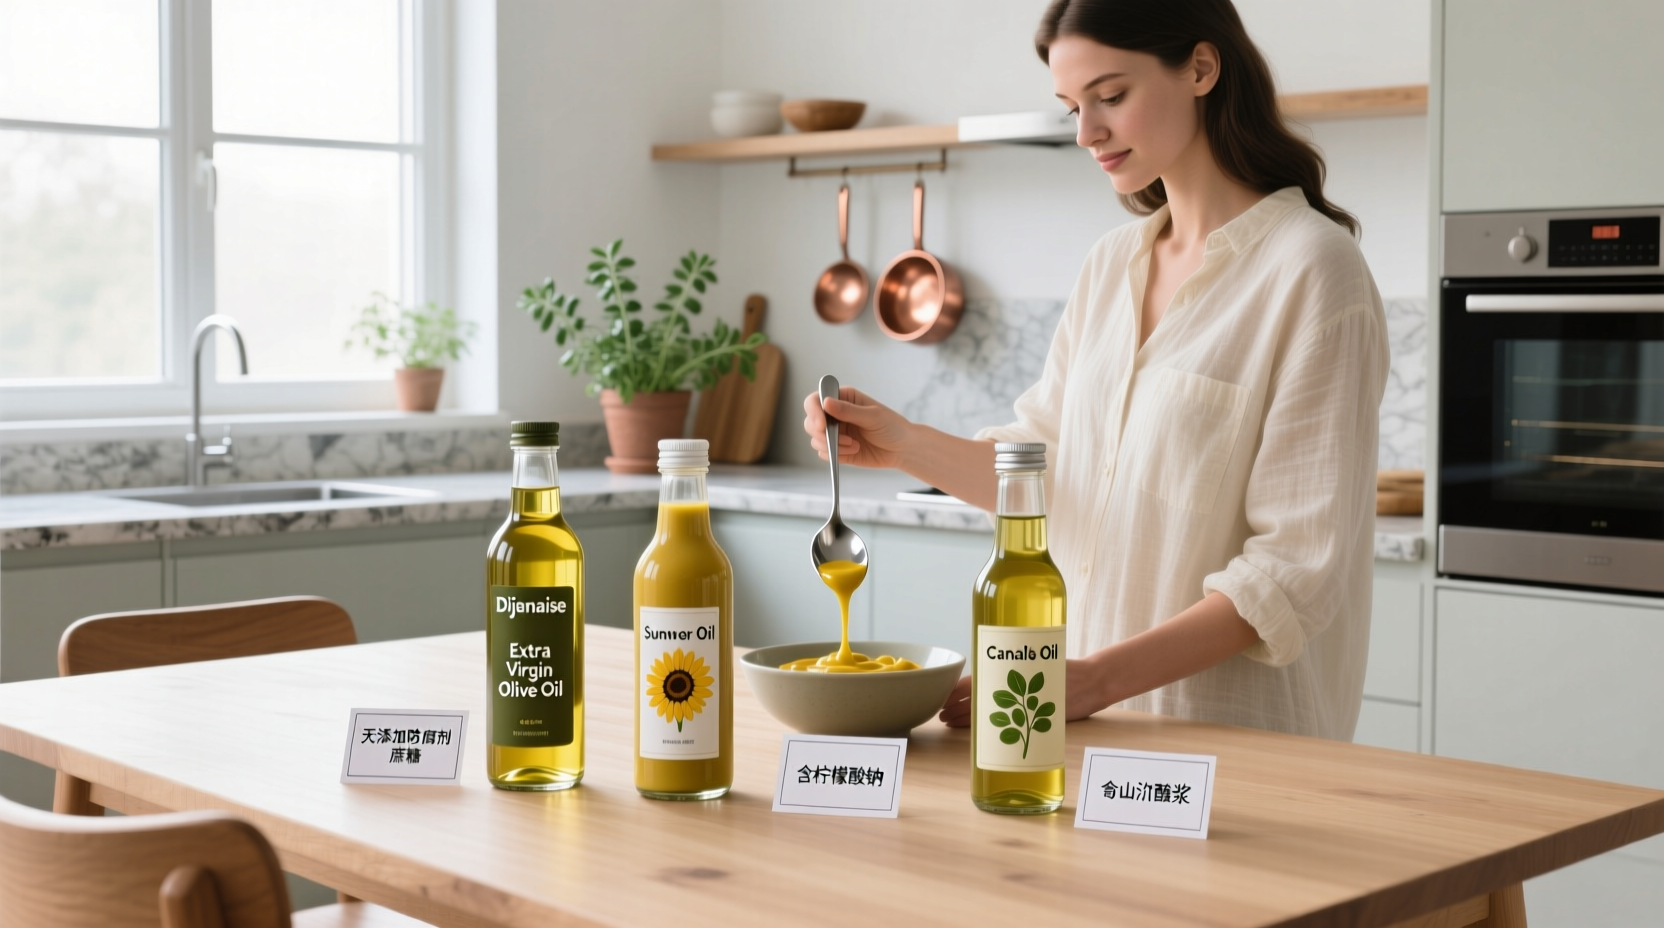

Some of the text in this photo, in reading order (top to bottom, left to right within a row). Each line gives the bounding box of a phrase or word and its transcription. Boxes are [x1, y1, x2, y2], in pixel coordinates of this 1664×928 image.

[696, 624, 715, 640] Oil
[509, 642, 551, 659] Extra
[1040, 643, 1058, 661] Oil
[506, 661, 553, 683] Virgin
[498, 680, 563, 698] Olive Oil
